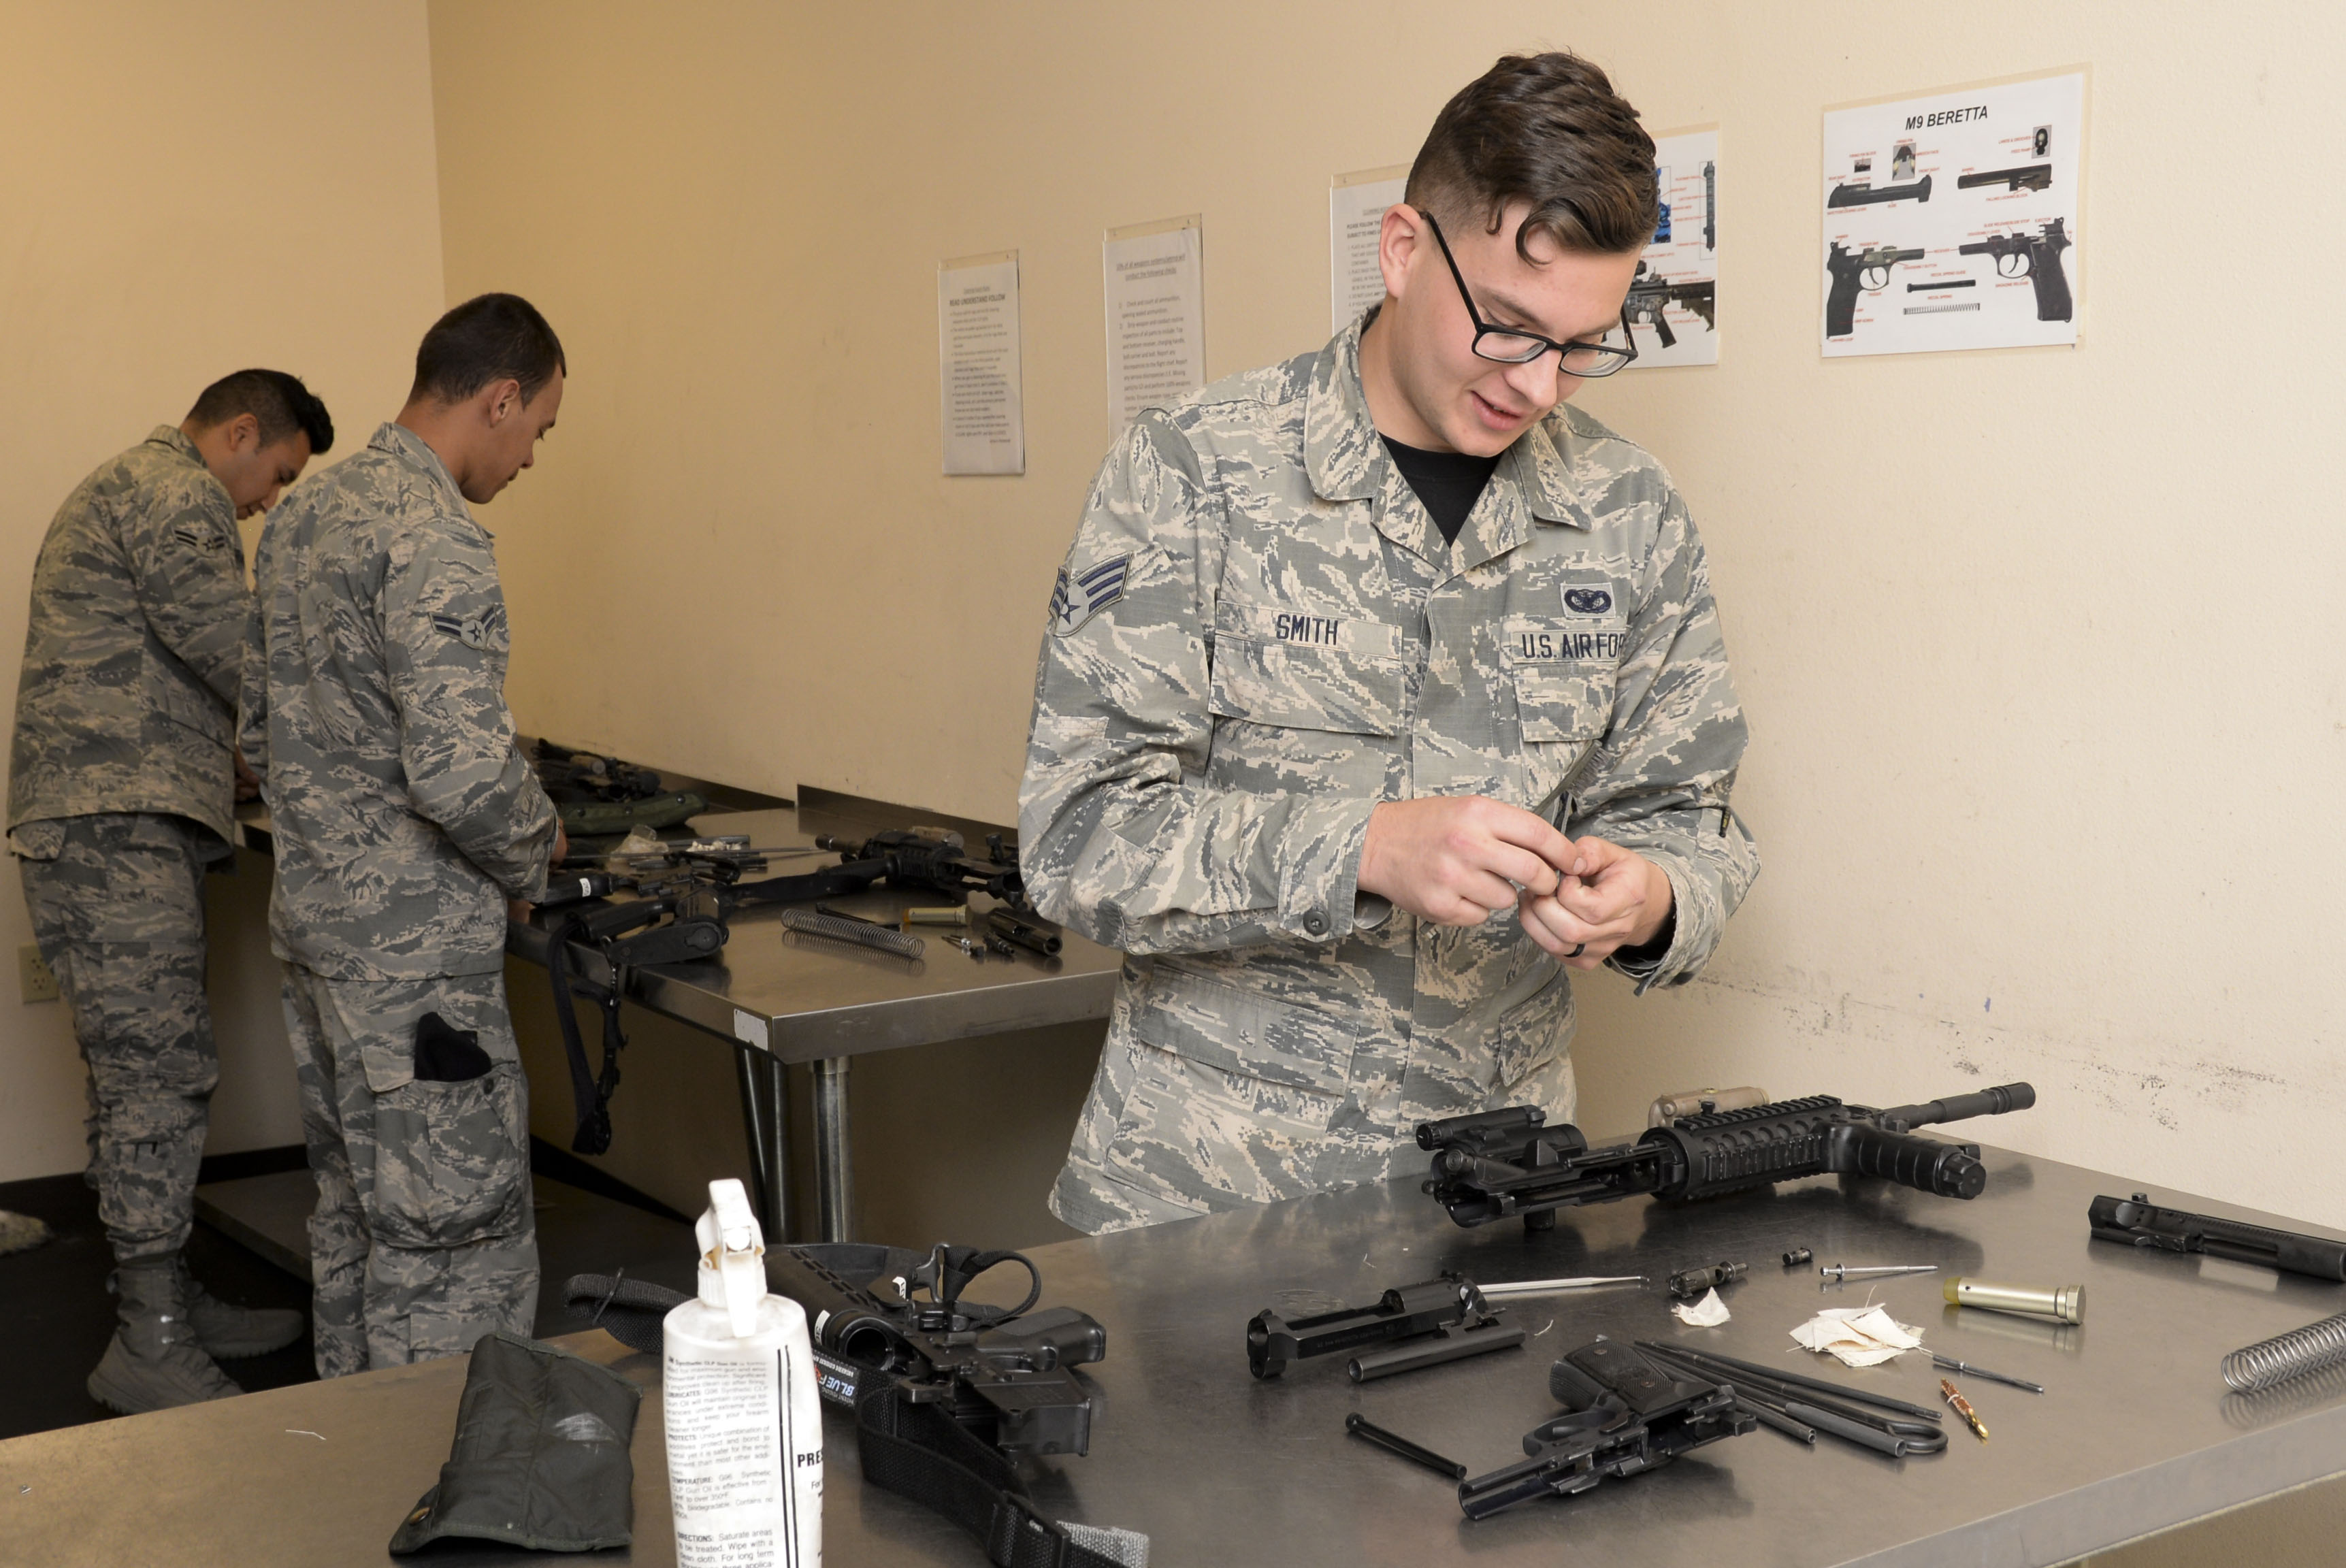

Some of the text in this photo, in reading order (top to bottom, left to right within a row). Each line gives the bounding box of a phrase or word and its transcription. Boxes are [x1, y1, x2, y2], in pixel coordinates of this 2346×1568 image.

[1905, 105, 1987, 130] M9 BERETTA
[1276, 614, 1338, 645] SMITH
[1522, 634, 1557, 659] U.S.
[1562, 633, 1593, 659] AIR
[826, 1376, 855, 1396] BLUE
[704, 1413, 721, 1422] keep
[726, 1411, 740, 1420] your
[746, 1409, 769, 1417] firearm
[723, 1426, 762, 1437] combination
[700, 1439, 723, 1450] protect
[713, 1447, 729, 1456] safer
[698, 1458, 713, 1467] than
[734, 1454, 751, 1462] other
[741, 1469, 772, 1480] Synthetic
[685, 1486, 700, 1494] Gun
[702, 1484, 712, 1493] Oil
[722, 1481, 749, 1490] effective
[694, 1494, 708, 1503] over
[735, 1497, 762, 1506] Contains
[719, 1531, 750, 1541] Saturate
[751, 1529, 773, 1537] areas
[685, 1544, 693, 1552] be
[728, 1542, 747, 1551] Wipe
[751, 1539, 766, 1548] with
[721, 1553, 734, 1562] For
[738, 1551, 753, 1561] long
[757, 1549, 774, 1558] term
